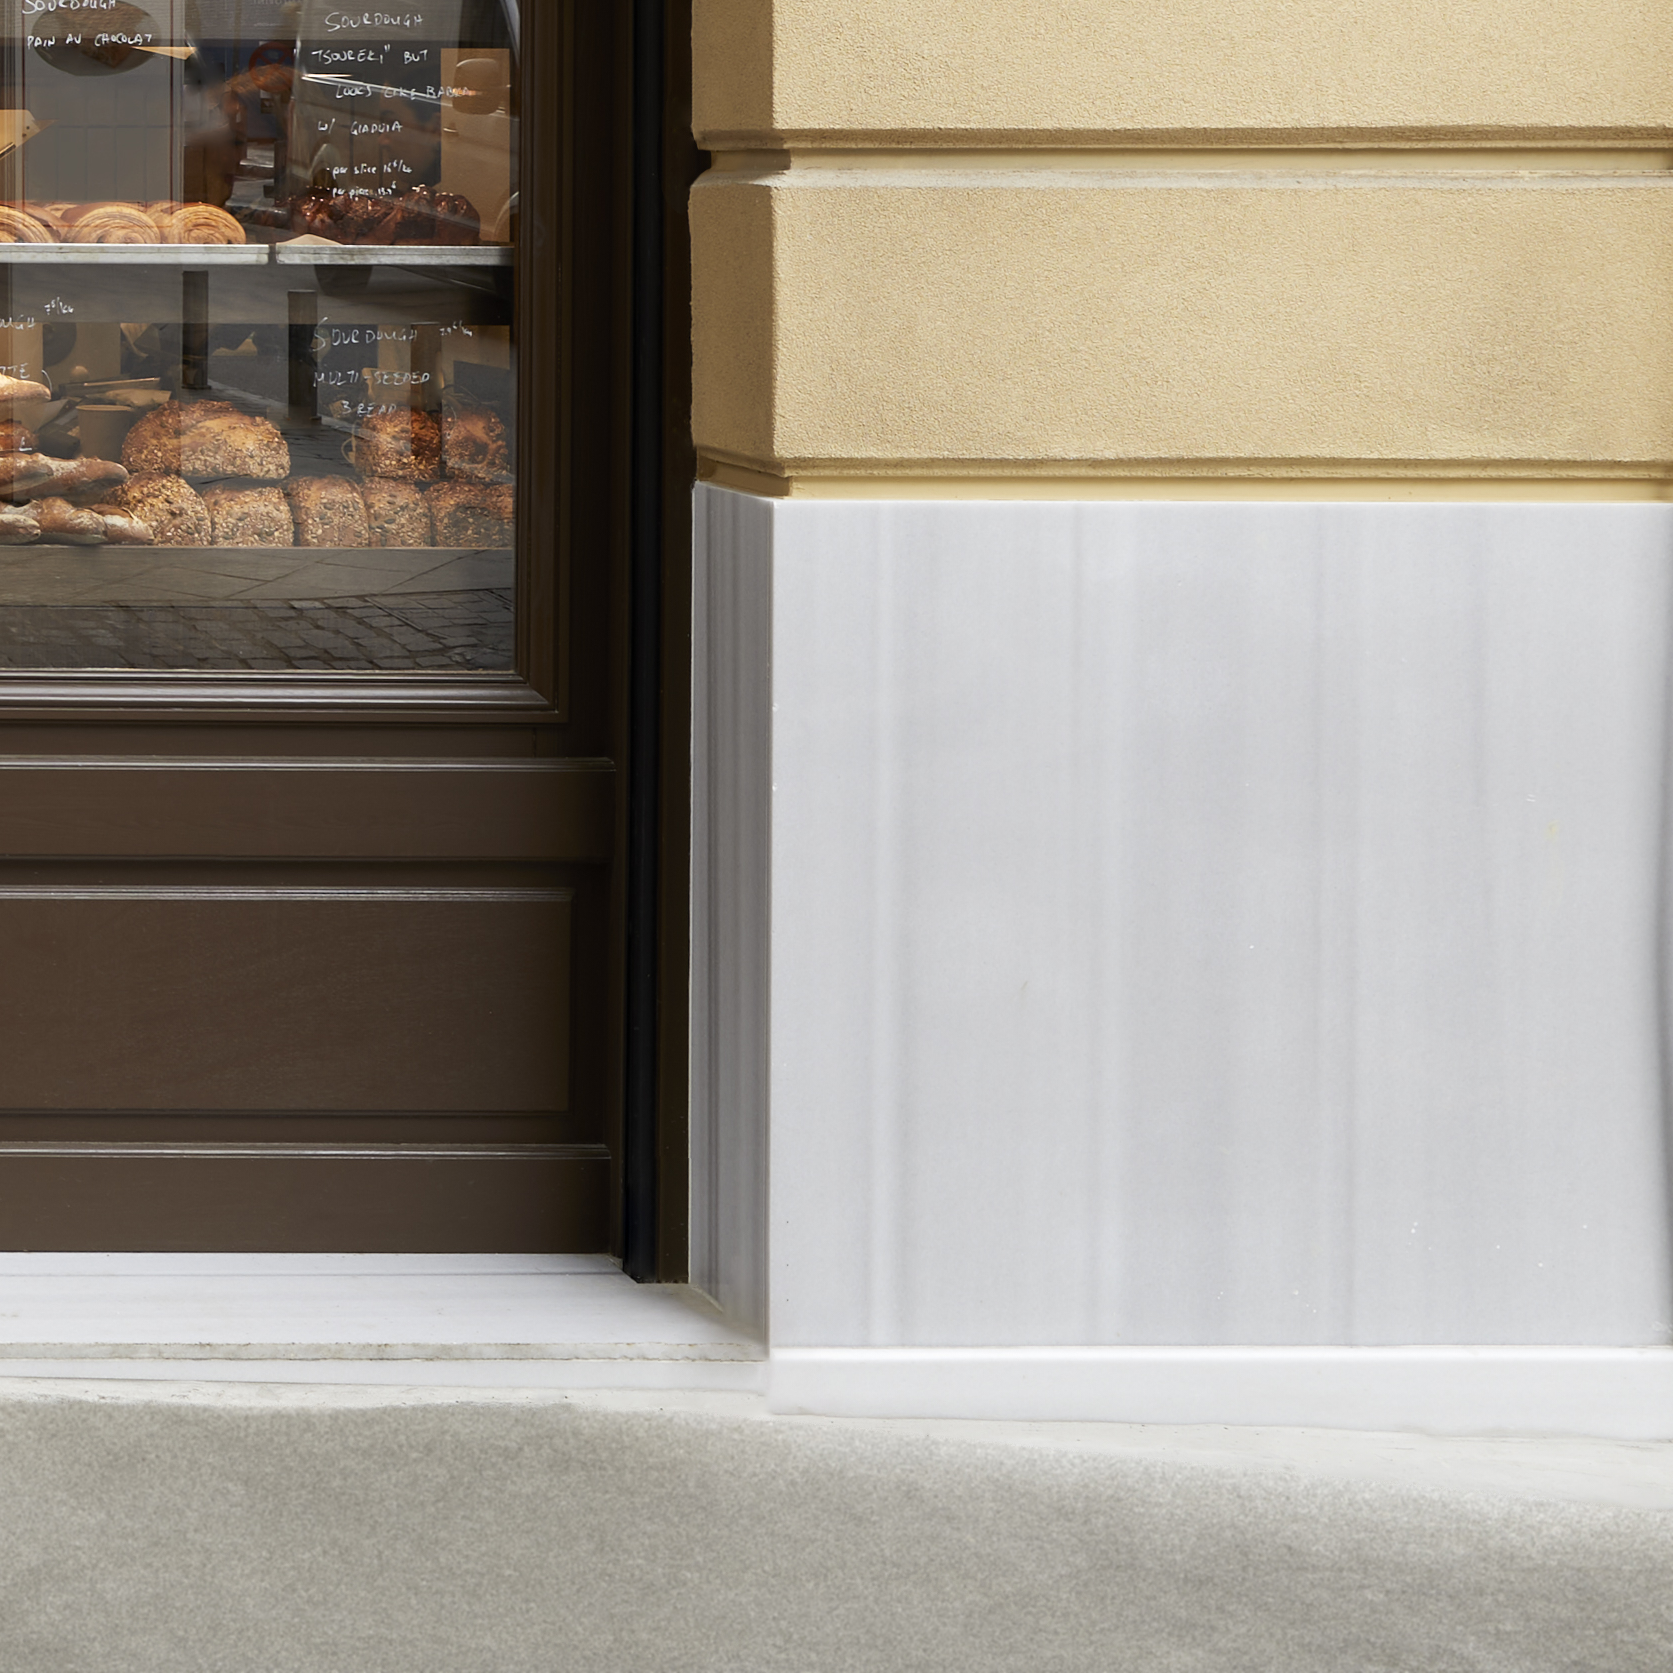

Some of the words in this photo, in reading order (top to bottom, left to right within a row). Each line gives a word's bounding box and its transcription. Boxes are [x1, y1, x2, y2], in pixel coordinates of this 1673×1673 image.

[325, 11, 425, 33] SOURDOUGH
[26, 34, 56, 50] PAIN
[65, 33, 82, 45] AU
[94, 32, 153, 47] CHOCOLAT
[403, 49, 429, 65] BUT
[310, 316, 419, 352] SOURDOUGH
[340, 400, 398, 418] BREAD
